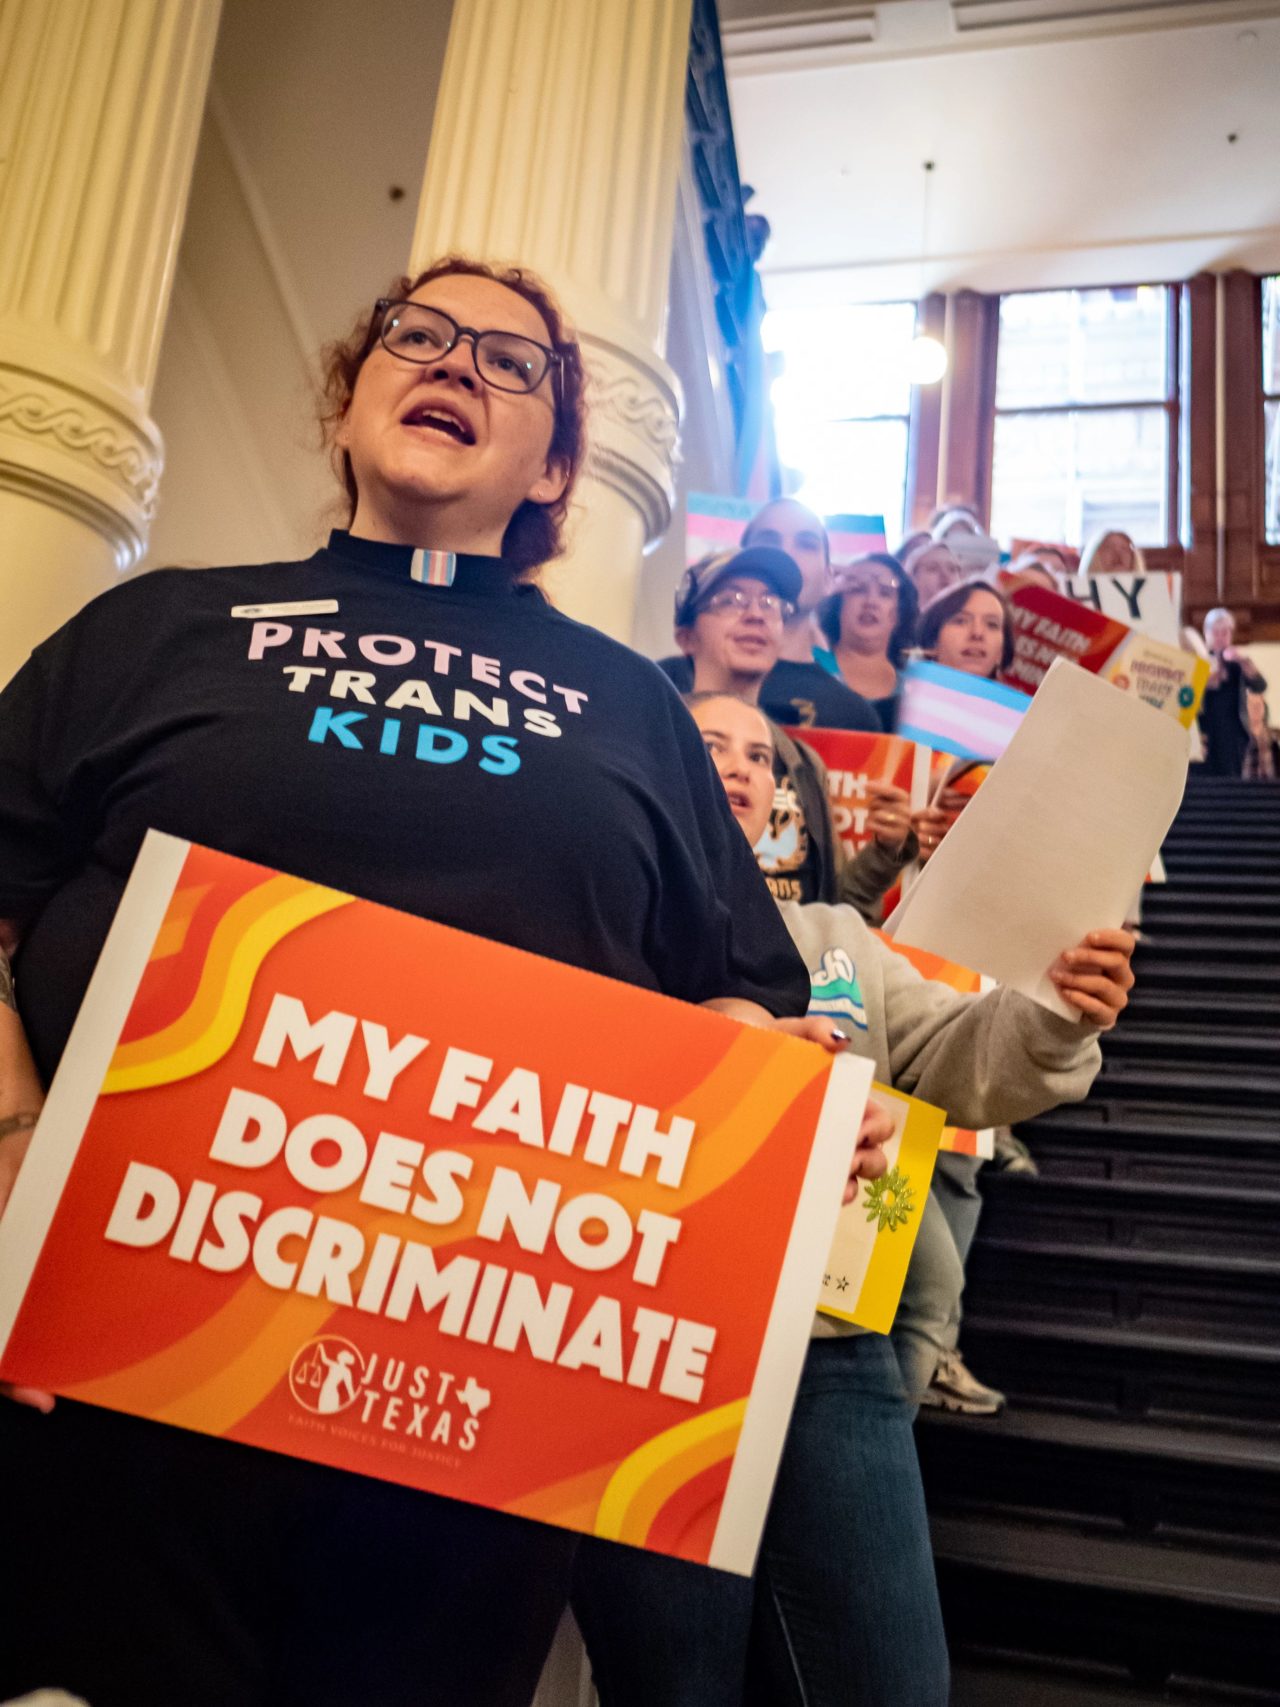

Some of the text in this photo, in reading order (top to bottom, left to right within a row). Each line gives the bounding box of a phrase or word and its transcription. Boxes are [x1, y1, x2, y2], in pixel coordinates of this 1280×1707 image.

[247, 621, 589, 715] PROTECT
[283, 665, 562, 738] TRANS
[308, 706, 522, 776] KIDS
[252, 992, 697, 1189] MY FAITH
[208, 1086, 683, 1288] DOES NOT
[104, 1160, 717, 1404] DISCRIMINATE
[360, 1352, 455, 1406] JUST
[360, 1389, 480, 1451] TEXAS
